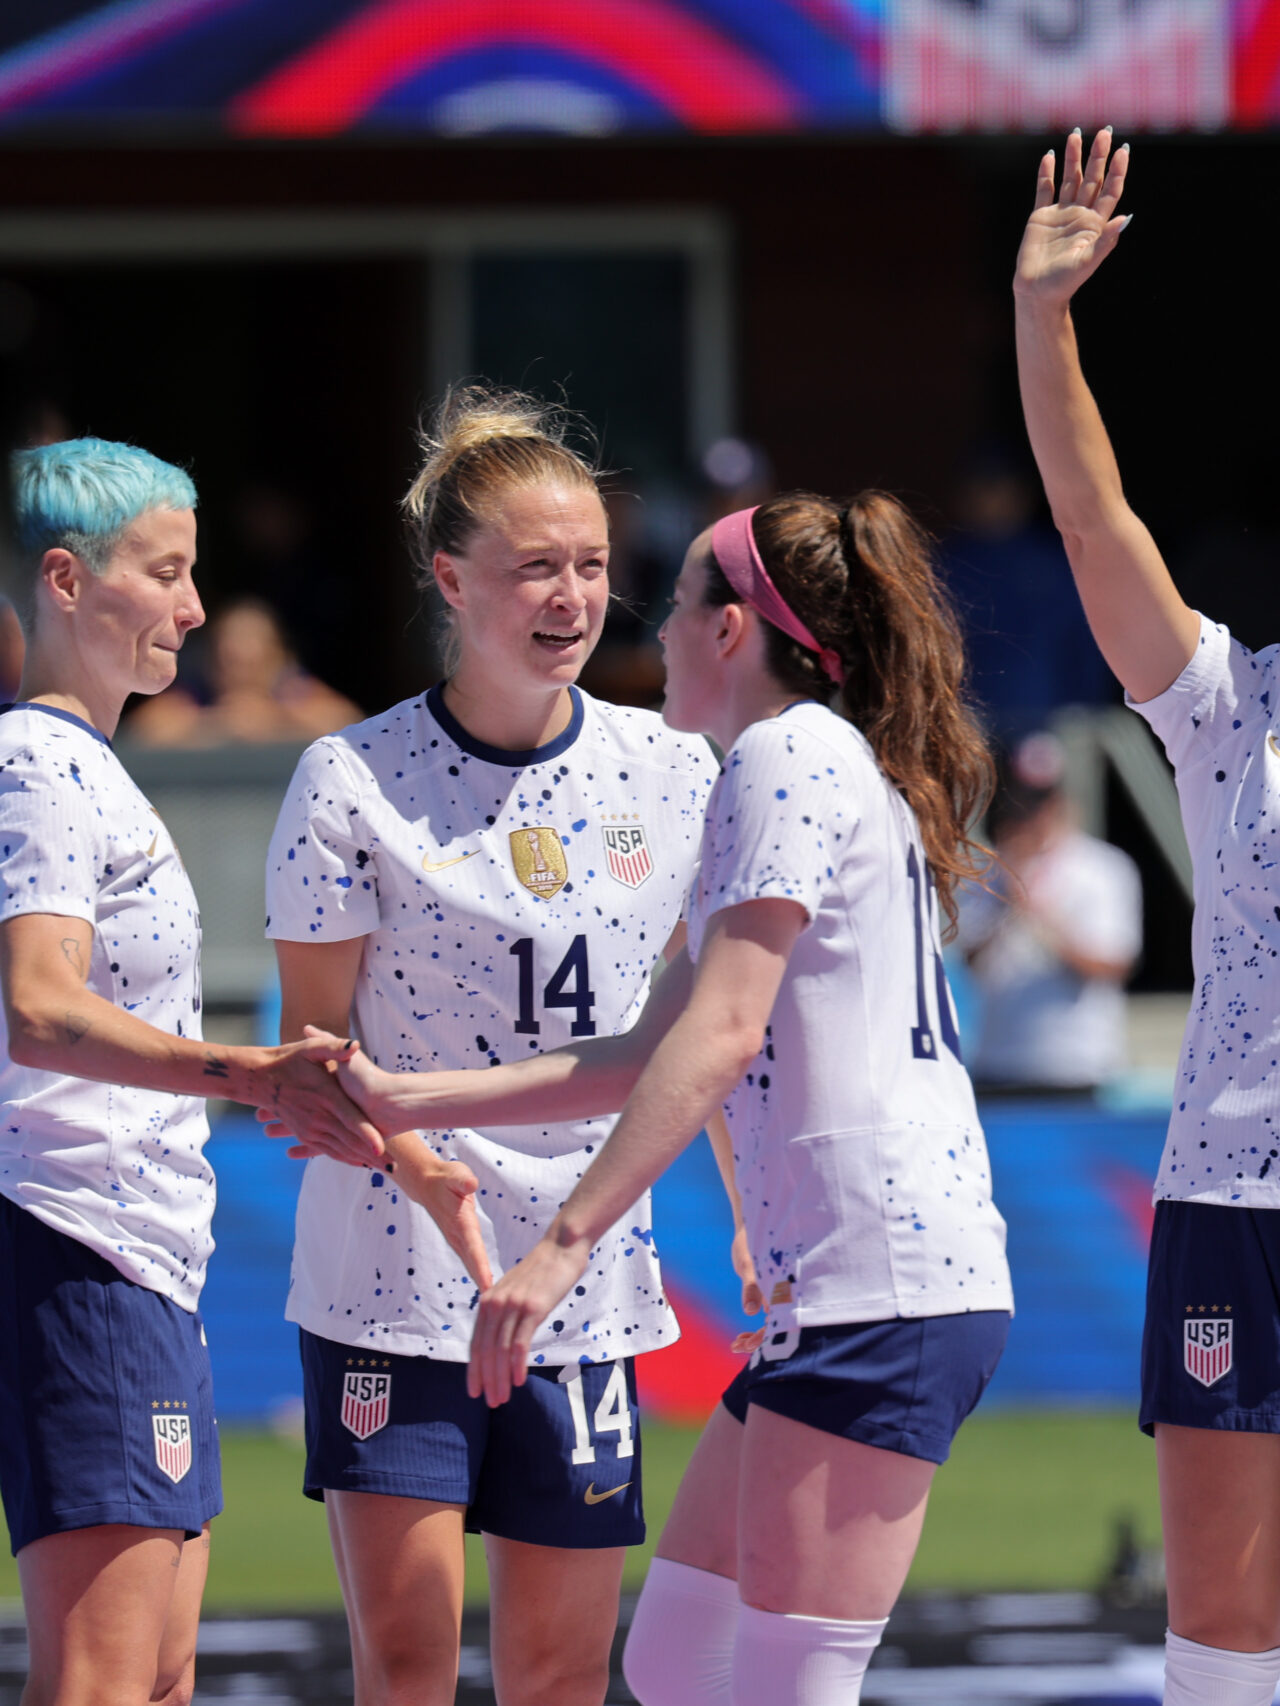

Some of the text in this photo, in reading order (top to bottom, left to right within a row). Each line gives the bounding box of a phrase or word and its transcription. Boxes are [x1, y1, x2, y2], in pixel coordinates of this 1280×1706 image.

[605, 829, 643, 854] USA
[530, 871, 557, 882] FIFA
[509, 934, 596, 1037] 14
[1187, 1322, 1230, 1348] USA
[347, 1376, 387, 1401] USA
[557, 1359, 634, 1465] 14
[156, 1418, 188, 1444] USA
